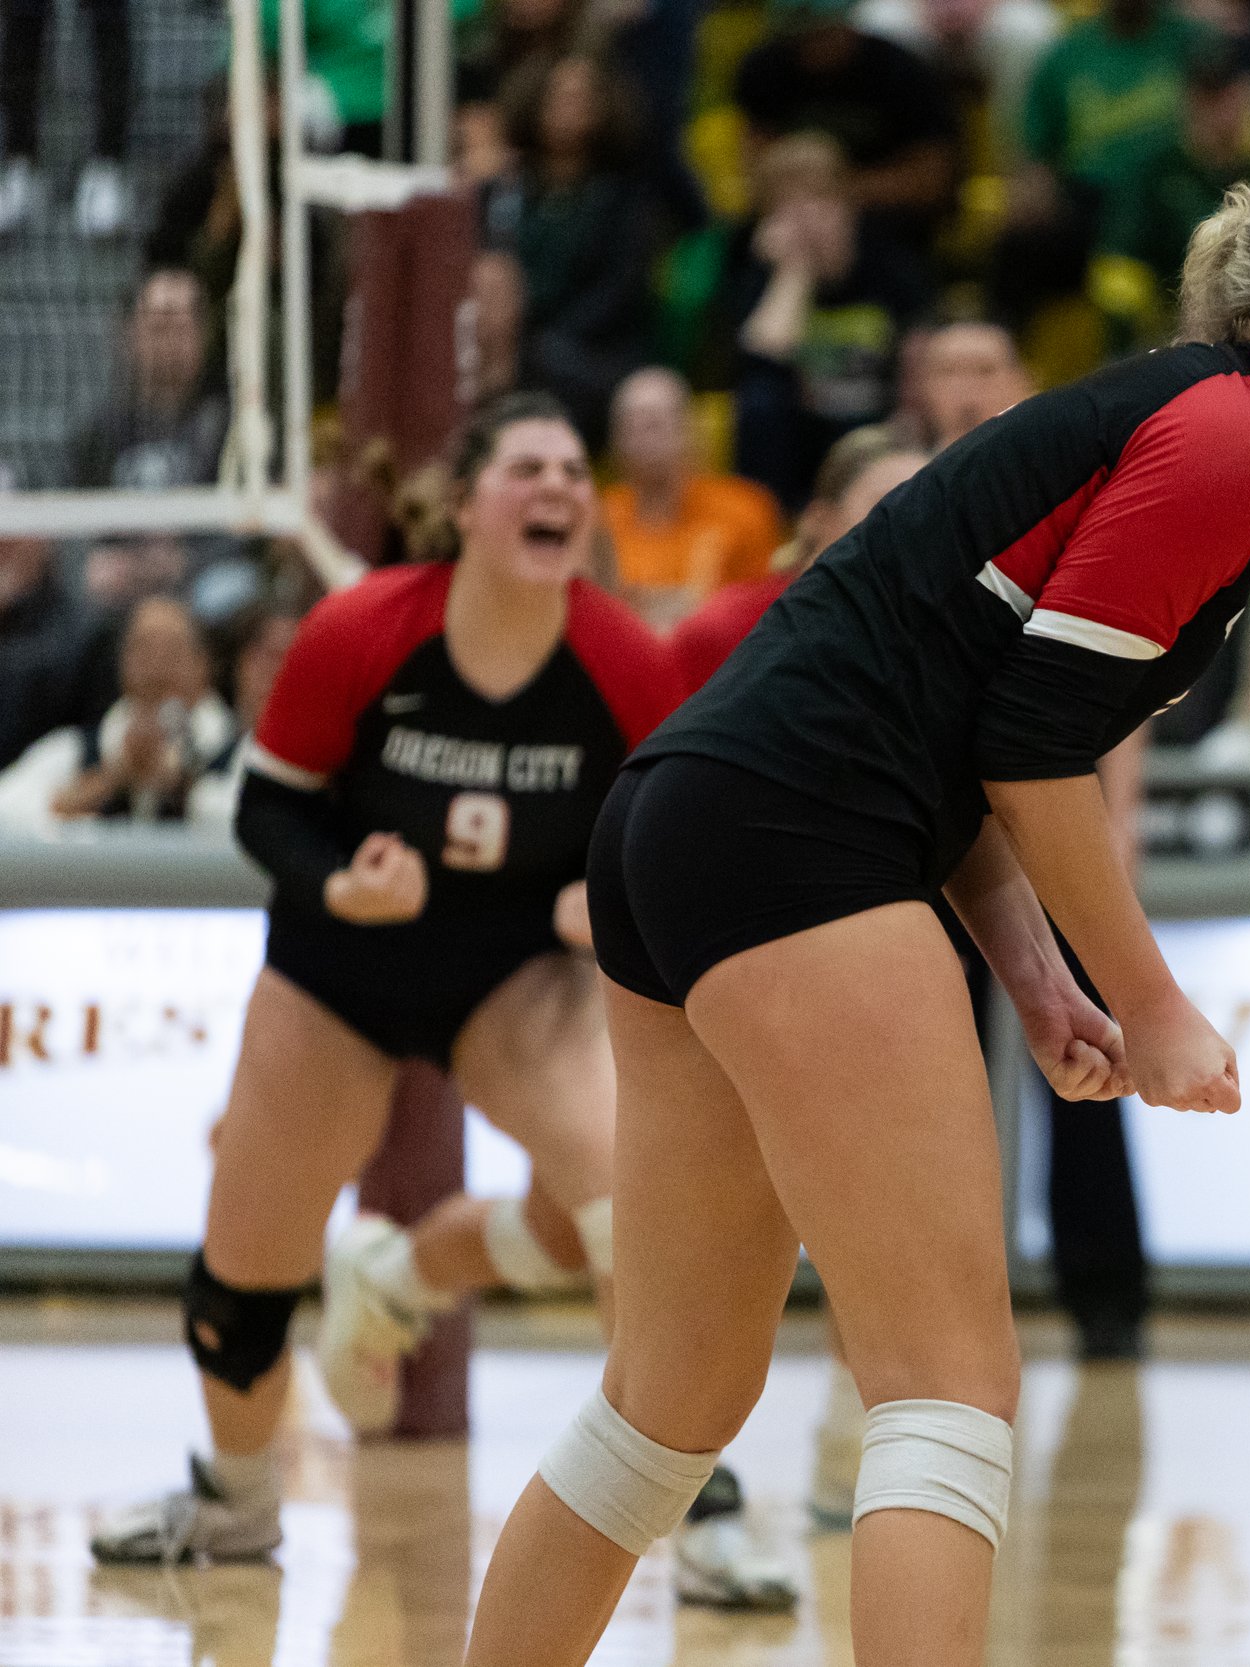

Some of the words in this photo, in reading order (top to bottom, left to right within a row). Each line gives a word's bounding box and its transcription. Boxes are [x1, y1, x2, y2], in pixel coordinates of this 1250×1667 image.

[381, 727, 503, 786] OREGON
[507, 745, 583, 791] CITY
[441, 792, 510, 872] 9
